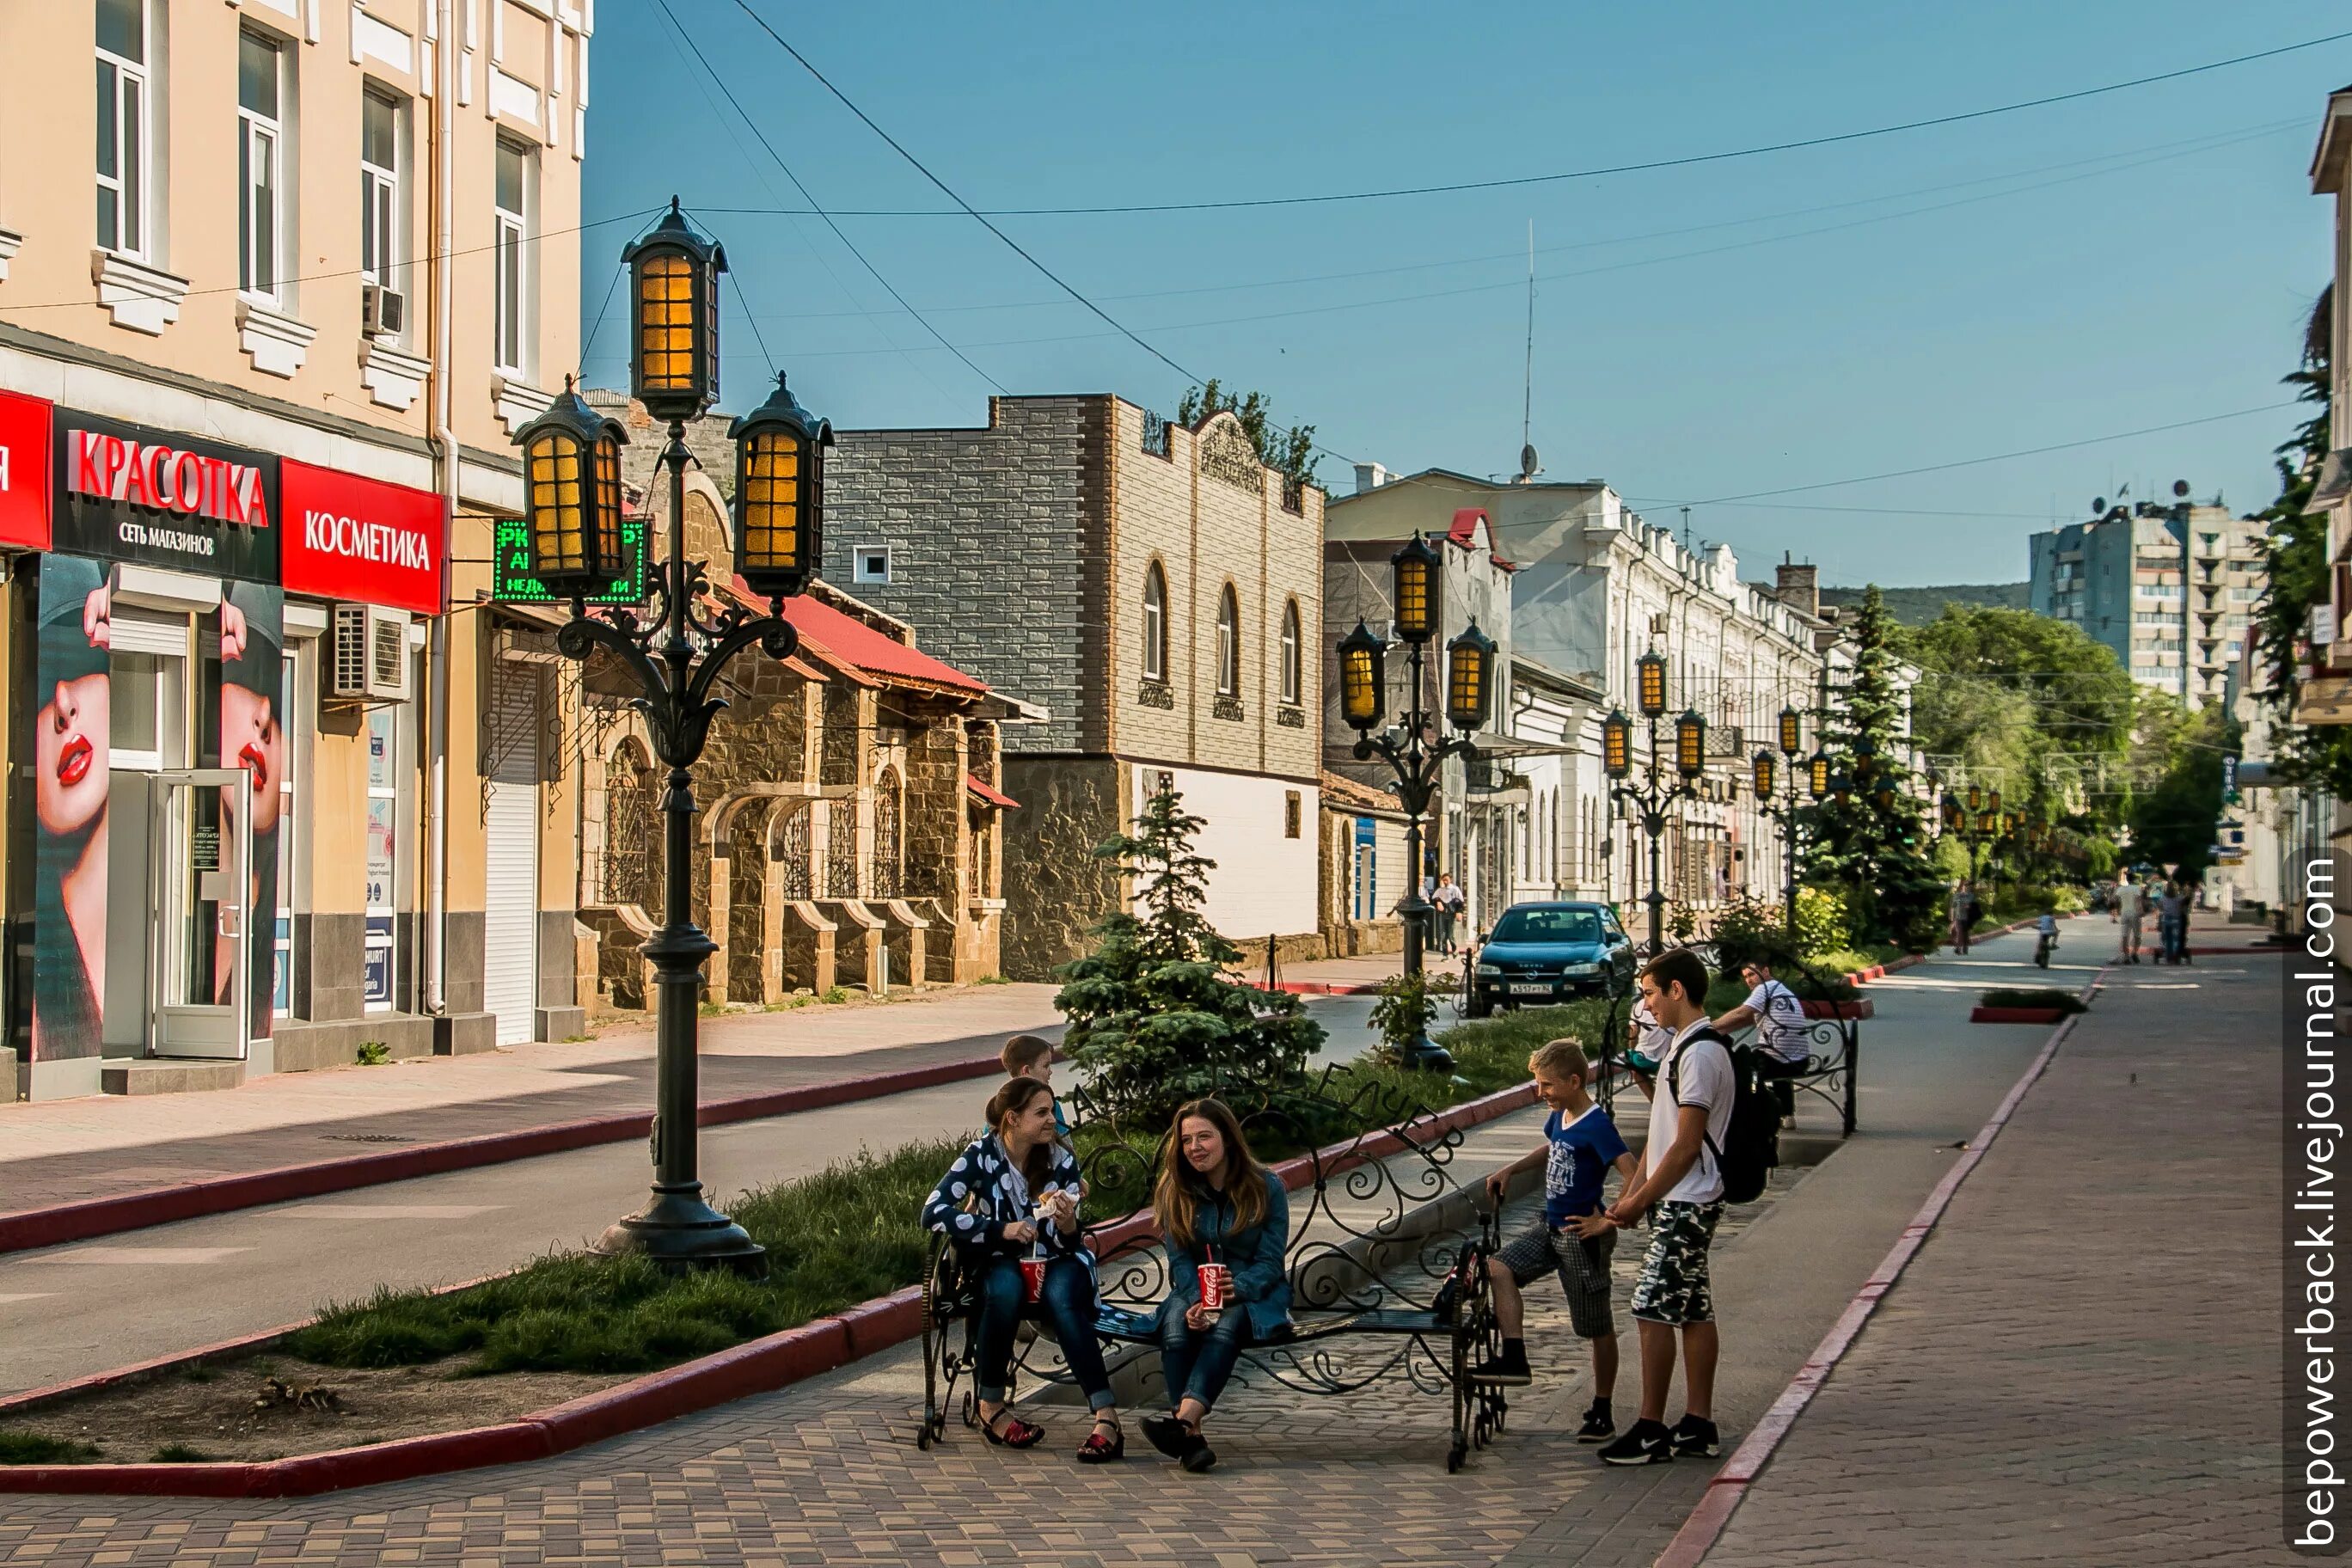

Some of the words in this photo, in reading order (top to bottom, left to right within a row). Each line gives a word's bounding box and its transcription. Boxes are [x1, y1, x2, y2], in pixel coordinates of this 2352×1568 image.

[69, 430, 268, 527] КРАСОТКА
[119, 522, 147, 544] СЕТЬ
[149, 527, 214, 555] МАГАЗИНОВ
[305, 510, 430, 571] КОСМЕТИКА
